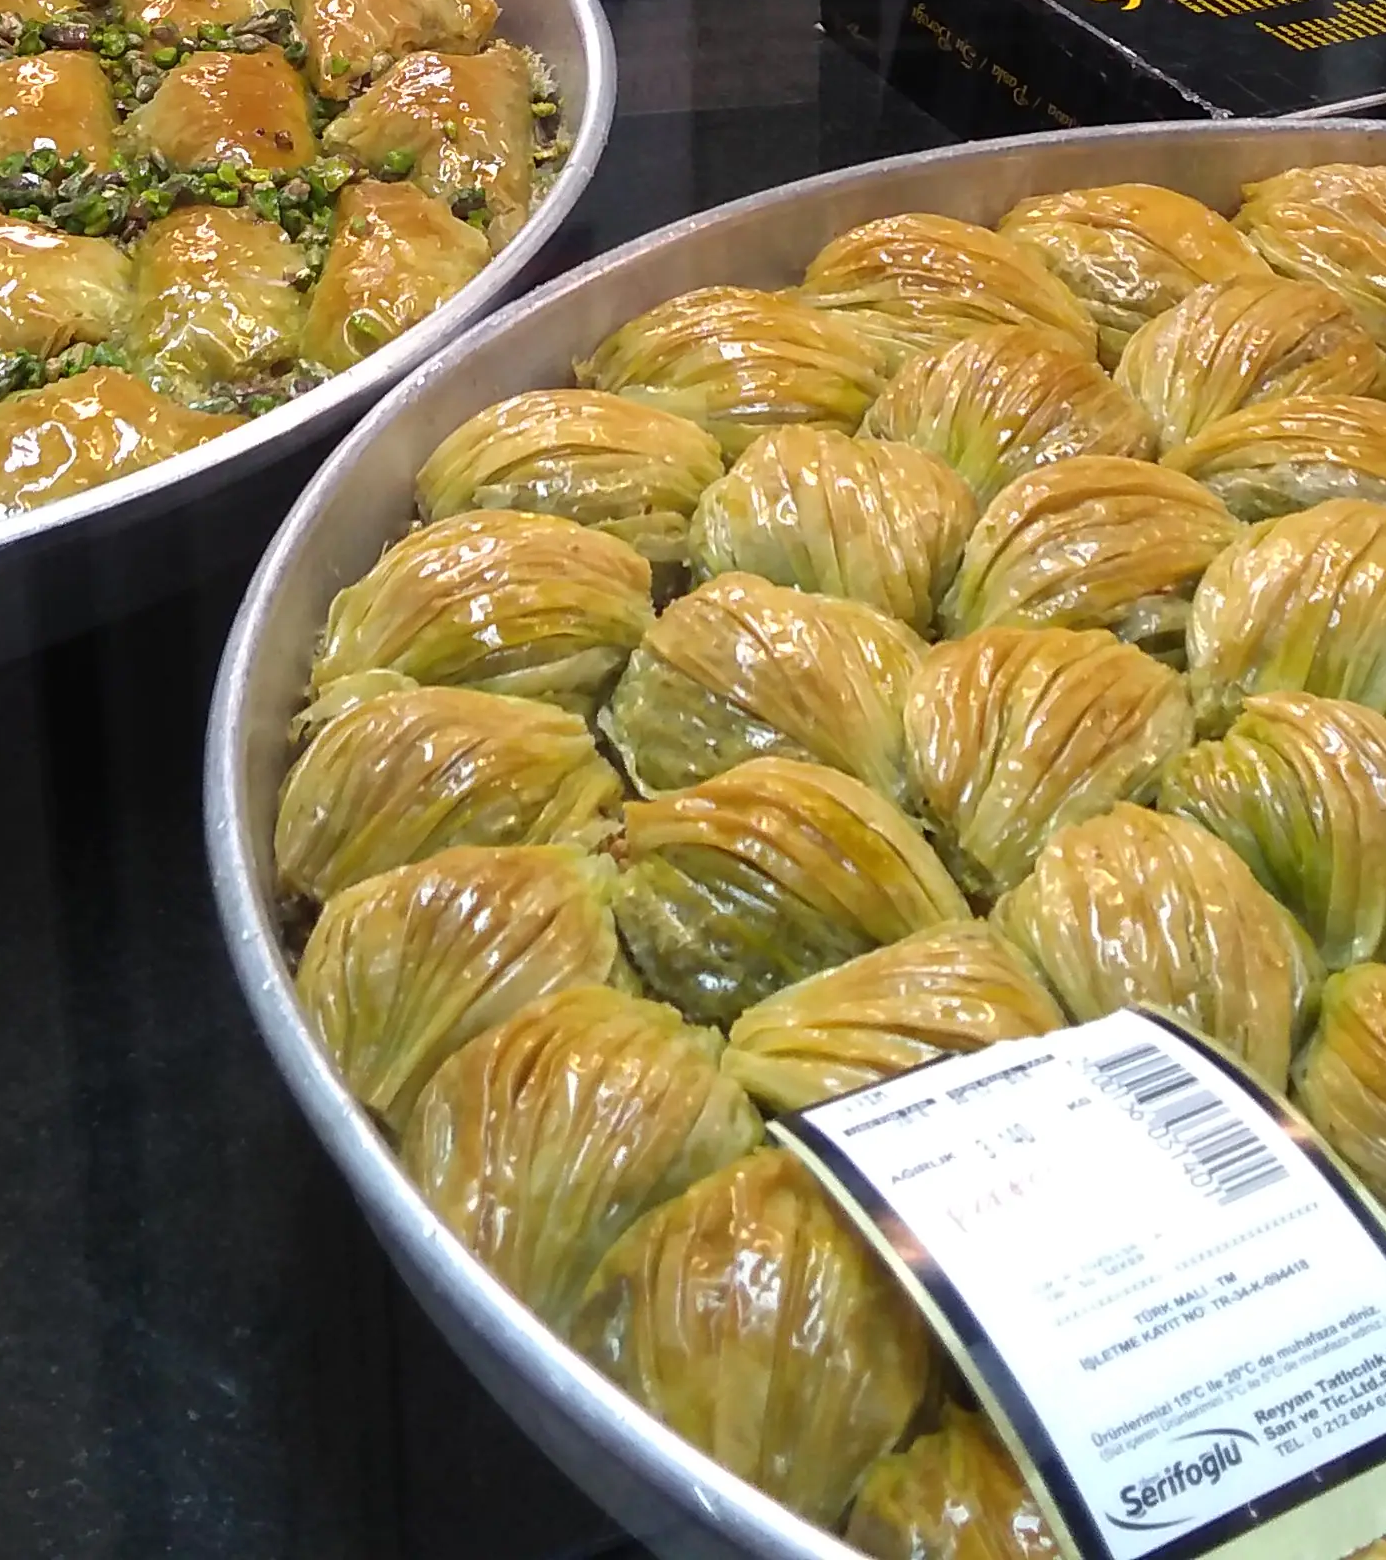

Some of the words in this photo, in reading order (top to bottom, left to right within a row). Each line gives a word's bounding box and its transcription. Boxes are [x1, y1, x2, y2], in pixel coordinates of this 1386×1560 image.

[1132, 1298, 1172, 1327] TÜRK
[1215, 1270, 1237, 1288] TM
[1090, 1399, 1173, 1449] Ürünlerimizi
[1256, 1351, 1276, 1369] de
[1275, 1322, 1339, 1360] muhafaza
[1254, 1388, 1315, 1427] Reyyan
[1261, 1414, 1297, 1442] San
[1298, 1406, 1320, 1425] ve
[1322, 1412, 1349, 1434] 212
[1348, 1399, 1375, 1421] 654
[1119, 1438, 1244, 1519] Şerifoğlu
